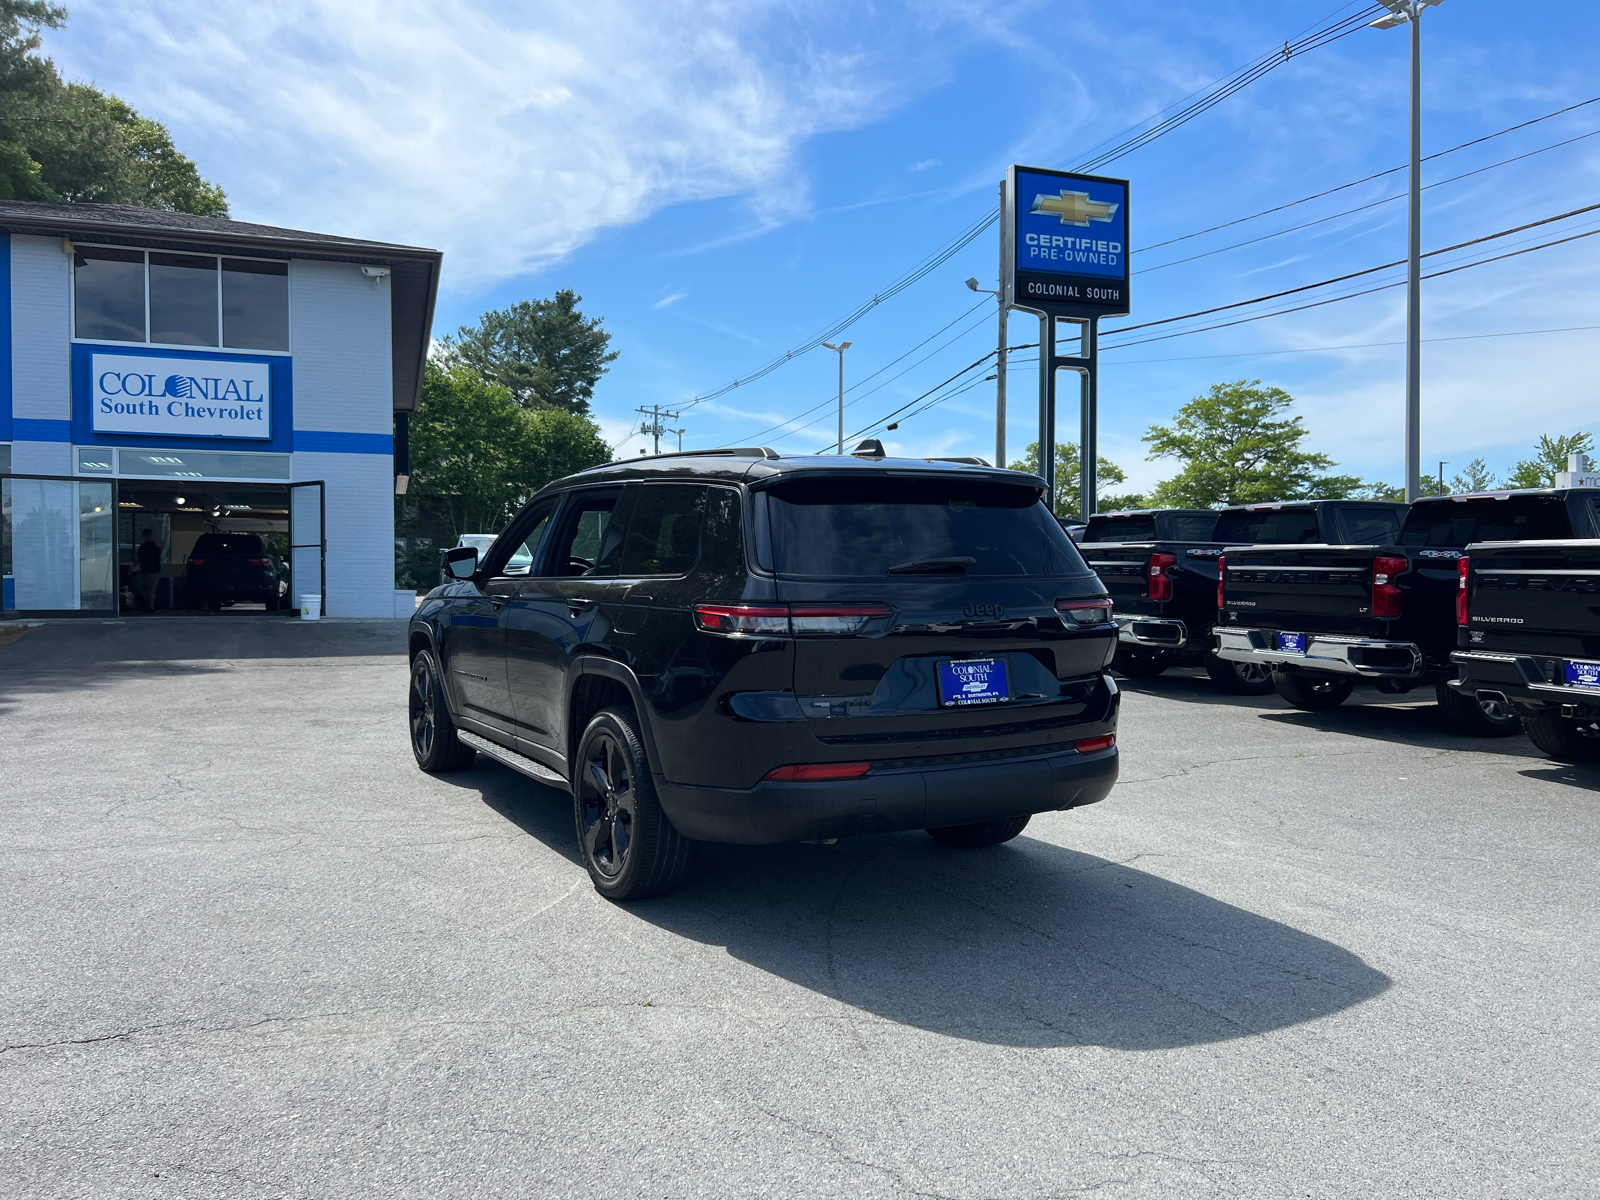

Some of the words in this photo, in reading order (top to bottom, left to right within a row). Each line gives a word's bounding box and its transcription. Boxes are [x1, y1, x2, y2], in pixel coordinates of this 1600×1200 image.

[1025, 233, 1122, 254] CERTIFIED
[1030, 247, 1117, 265] PRE-OWNED
[1028, 282, 1080, 297] COLONIAL
[1086, 287, 1120, 300] SOUTH
[99, 371, 264, 402] COLONIAL
[100, 397, 160, 416] South
[166, 401, 264, 421] Chevrolet
[963, 601, 1005, 620] Jeep
[1472, 616, 1524, 624] SILVERADO
[952, 665, 993, 675] COLONIAL
[959, 673, 988, 683] SOUTH
